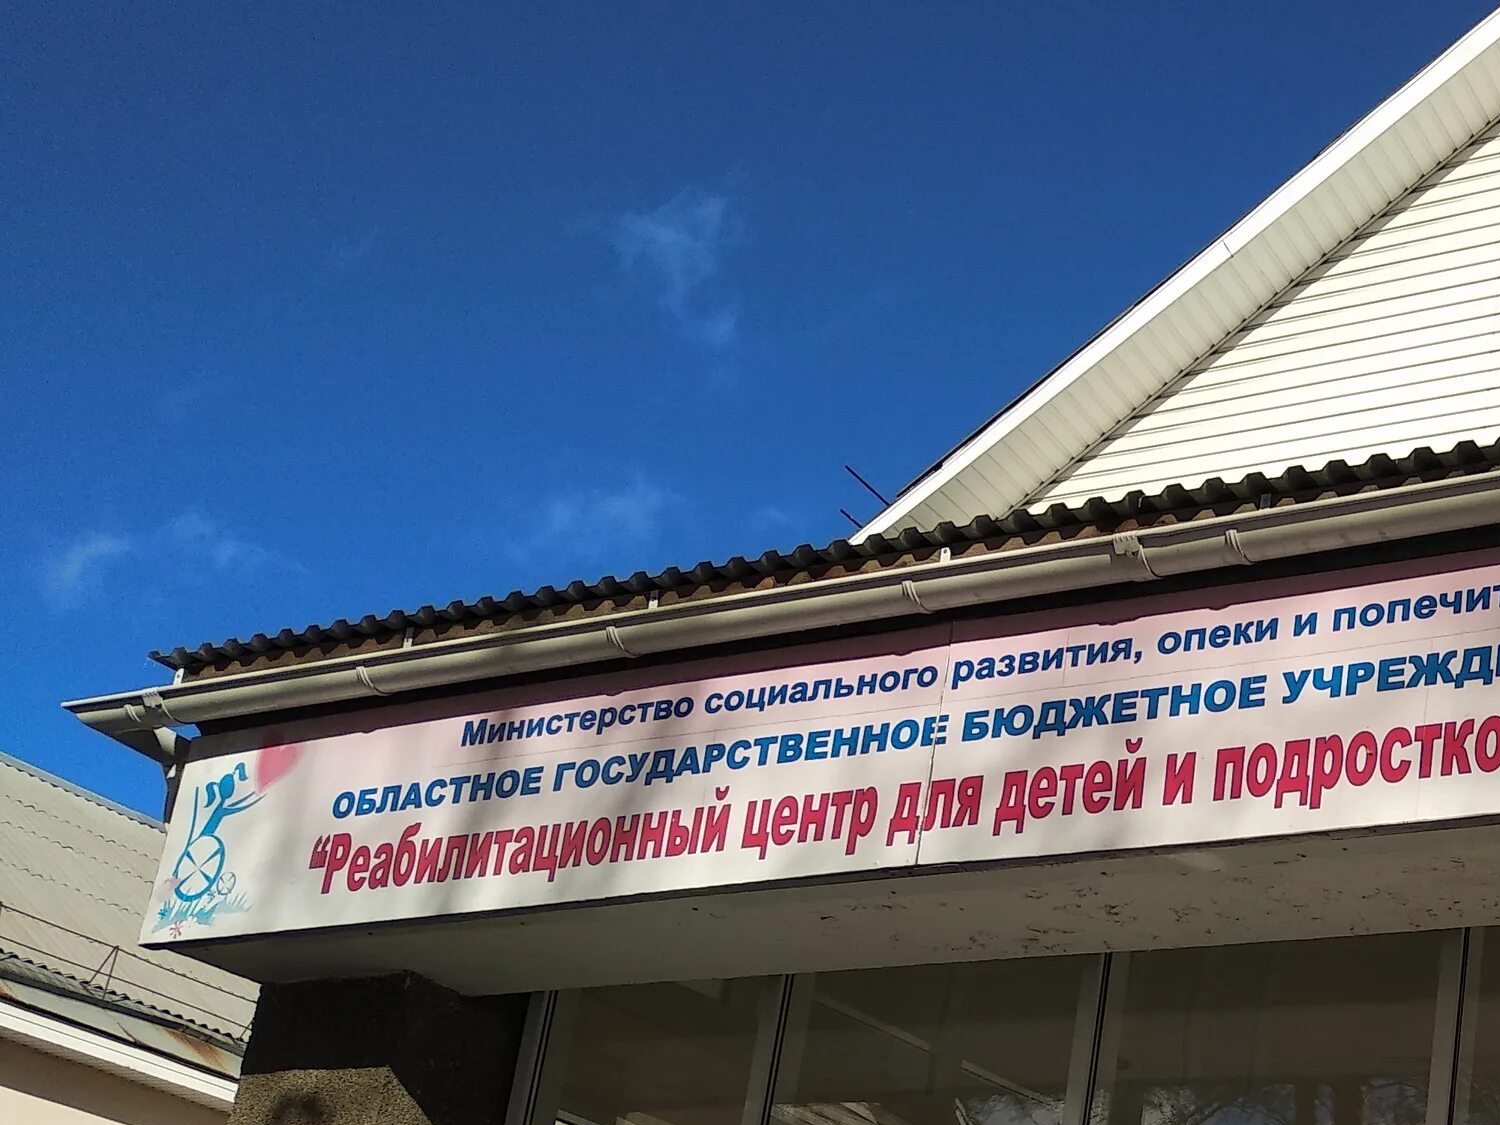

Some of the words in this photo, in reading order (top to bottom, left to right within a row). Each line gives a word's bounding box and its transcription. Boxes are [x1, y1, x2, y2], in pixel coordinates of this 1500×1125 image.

[332, 766, 544, 819] ОБЛАСТНОЕ
[552, 715, 950, 792] ГОСУДАРСТВЕННОЕ
[961, 674, 1267, 742] БЮДЖЕТНОЕ
[461, 695, 694, 747] Министерство
[704, 665, 938, 712] социального
[952, 637, 1143, 690] развития,
[1157, 617, 1279, 655] опеки
[1293, 612, 1318, 637] и
[741, 785, 878, 860] центр
[886, 775, 984, 847] для
[992, 737, 1146, 837] детей
[1162, 752, 1197, 806] и
